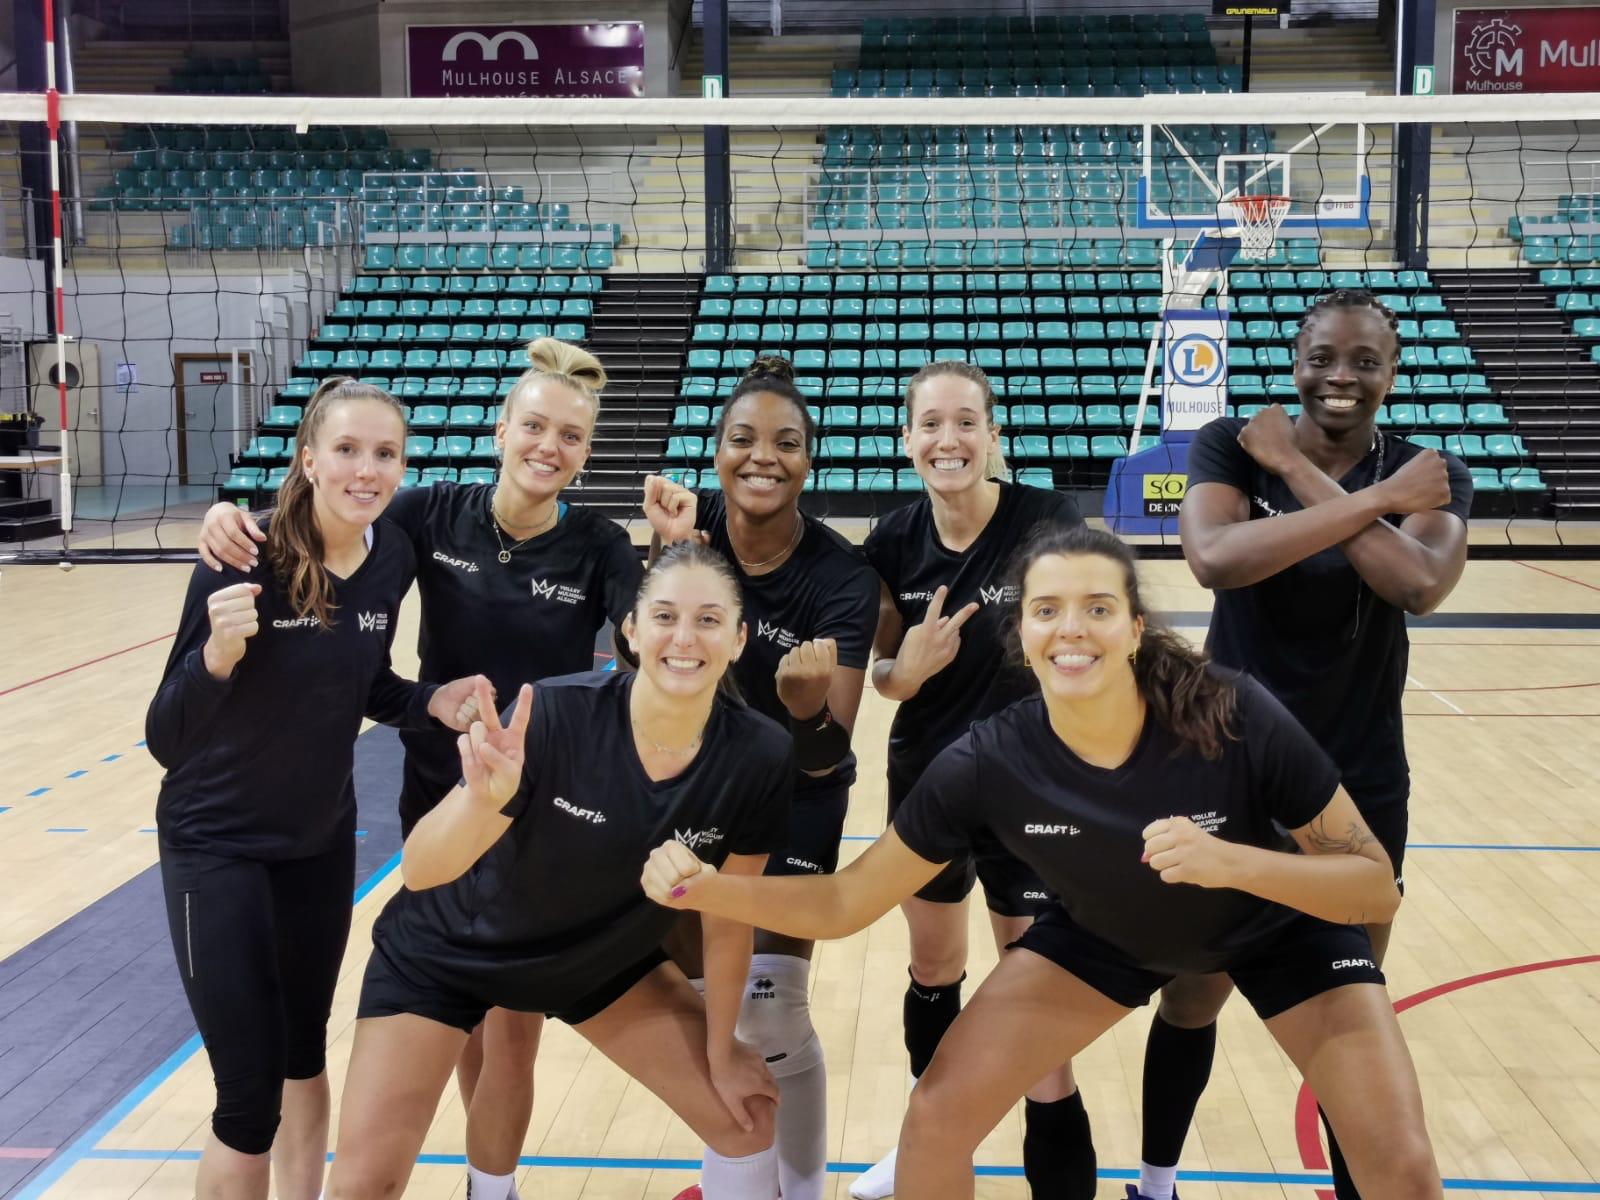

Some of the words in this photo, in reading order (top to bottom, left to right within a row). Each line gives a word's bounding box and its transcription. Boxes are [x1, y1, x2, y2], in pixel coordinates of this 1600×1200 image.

[1539, 39, 1600, 68] Mul
[1415, 68, 1433, 95] D
[1465, 80, 1523, 92] Mulhouse
[1183, 348, 1205, 376] L
[1166, 401, 1224, 414] MULHOUSE
[1150, 480, 1184, 495] SO
[1149, 503, 1163, 512] DE
[432, 551, 469, 569] CRAFT
[899, 592, 927, 601] CRAFT
[272, 617, 310, 629] CRAFT
[553, 797, 595, 820] CRAFT
[1191, 811, 1217, 821] VOLLEY
[1195, 816, 1228, 827] ULHOUSE
[1024, 824, 1068, 835] CRAFT
[786, 857, 818, 871] CRAFT
[1023, 891, 1048, 899] CRA
